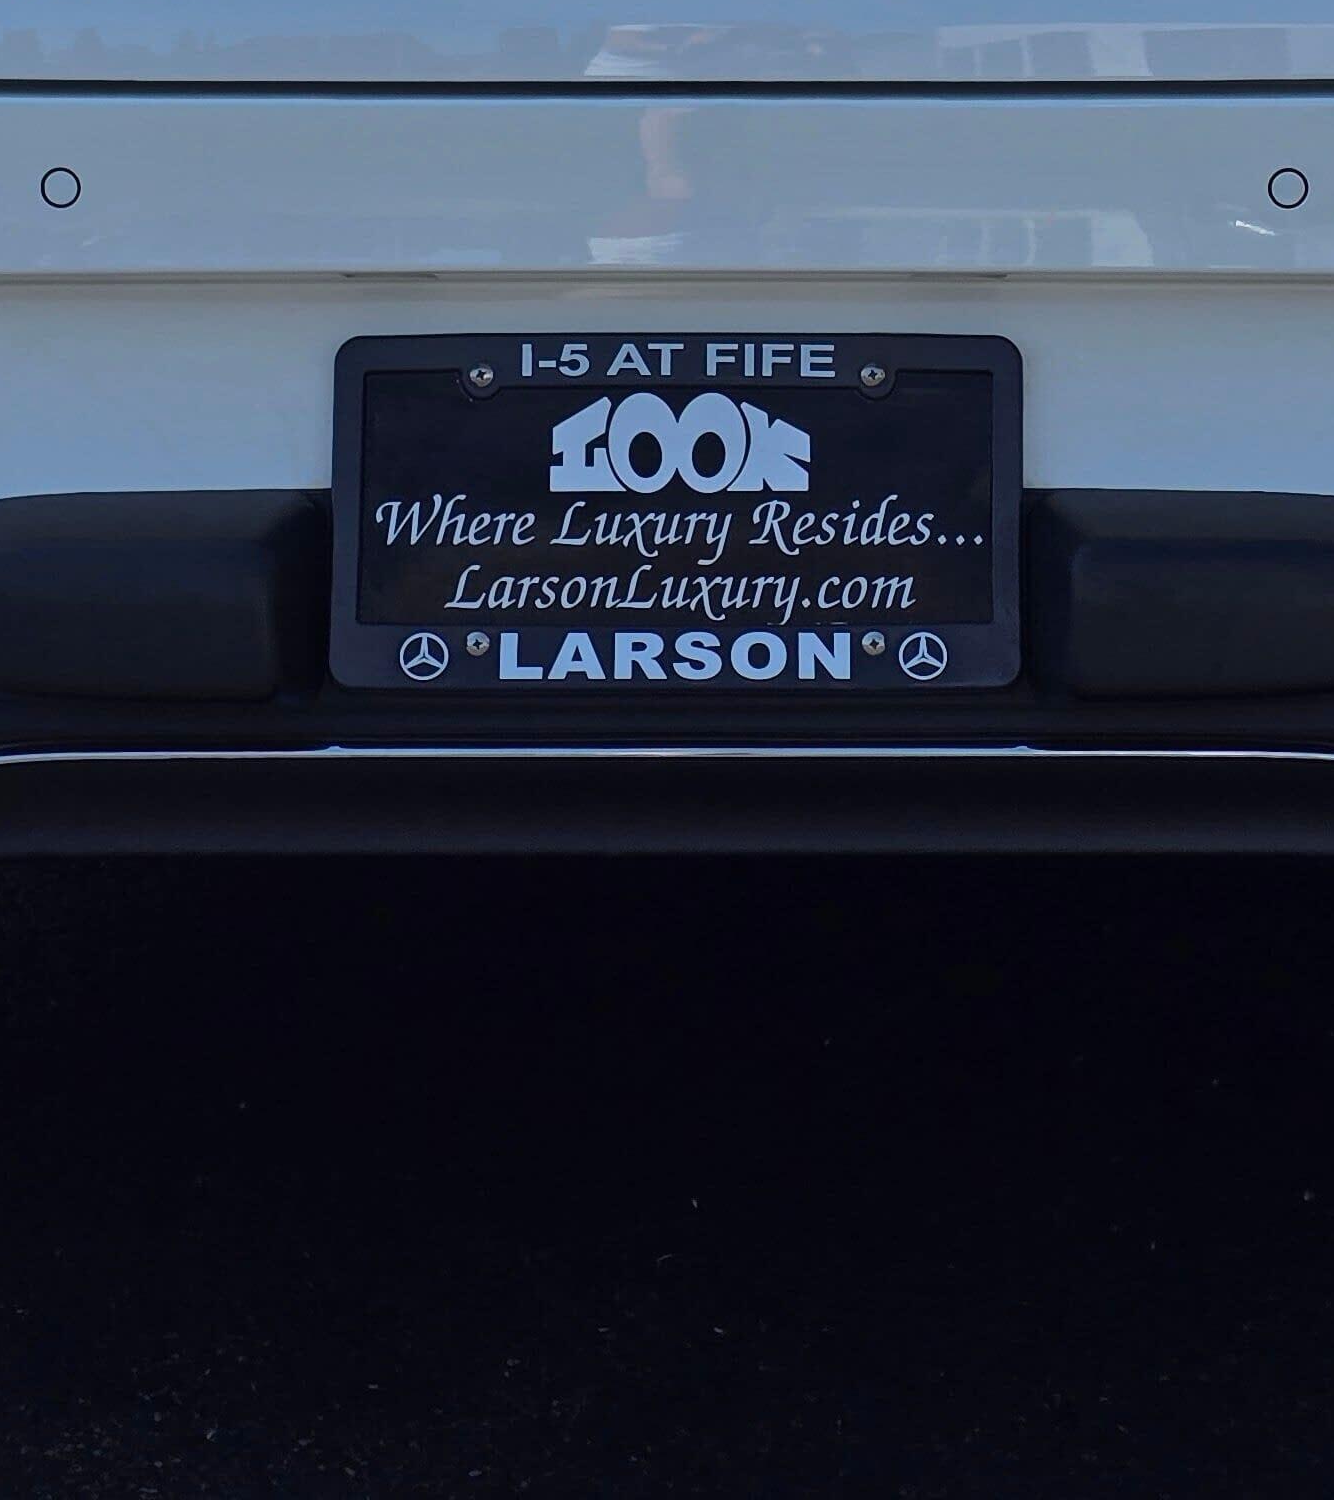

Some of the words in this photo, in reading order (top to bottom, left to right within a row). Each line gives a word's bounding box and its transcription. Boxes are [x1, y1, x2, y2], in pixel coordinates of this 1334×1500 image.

[521, 343, 590, 378] I-5
[607, 343, 685, 377] AT
[706, 343, 836, 378] FIFE
[375, 493, 536, 546] Where
[550, 501, 732, 566] Luxury
[748, 494, 985, 546] Resides...
[443, 564, 916, 626] LarsonLuxury.com
[499, 632, 851, 681] LARSON
